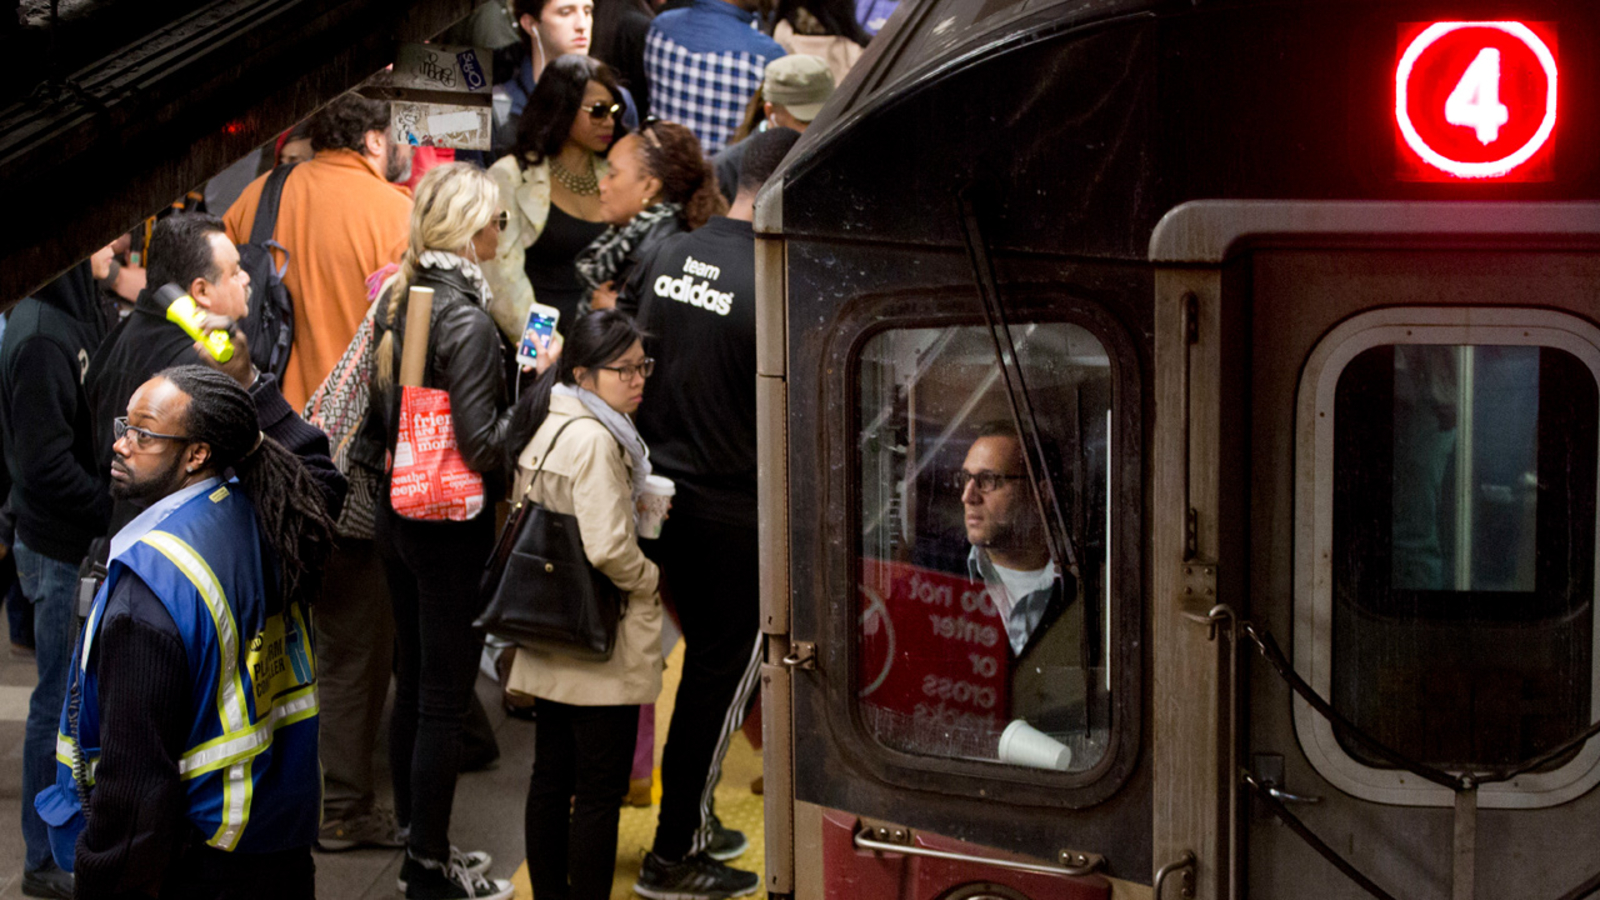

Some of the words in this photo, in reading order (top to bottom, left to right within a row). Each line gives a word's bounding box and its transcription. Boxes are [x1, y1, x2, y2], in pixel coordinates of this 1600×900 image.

[1445, 47, 1508, 145] 4
[683, 255, 720, 280] team
[654, 275, 734, 315] adidas
